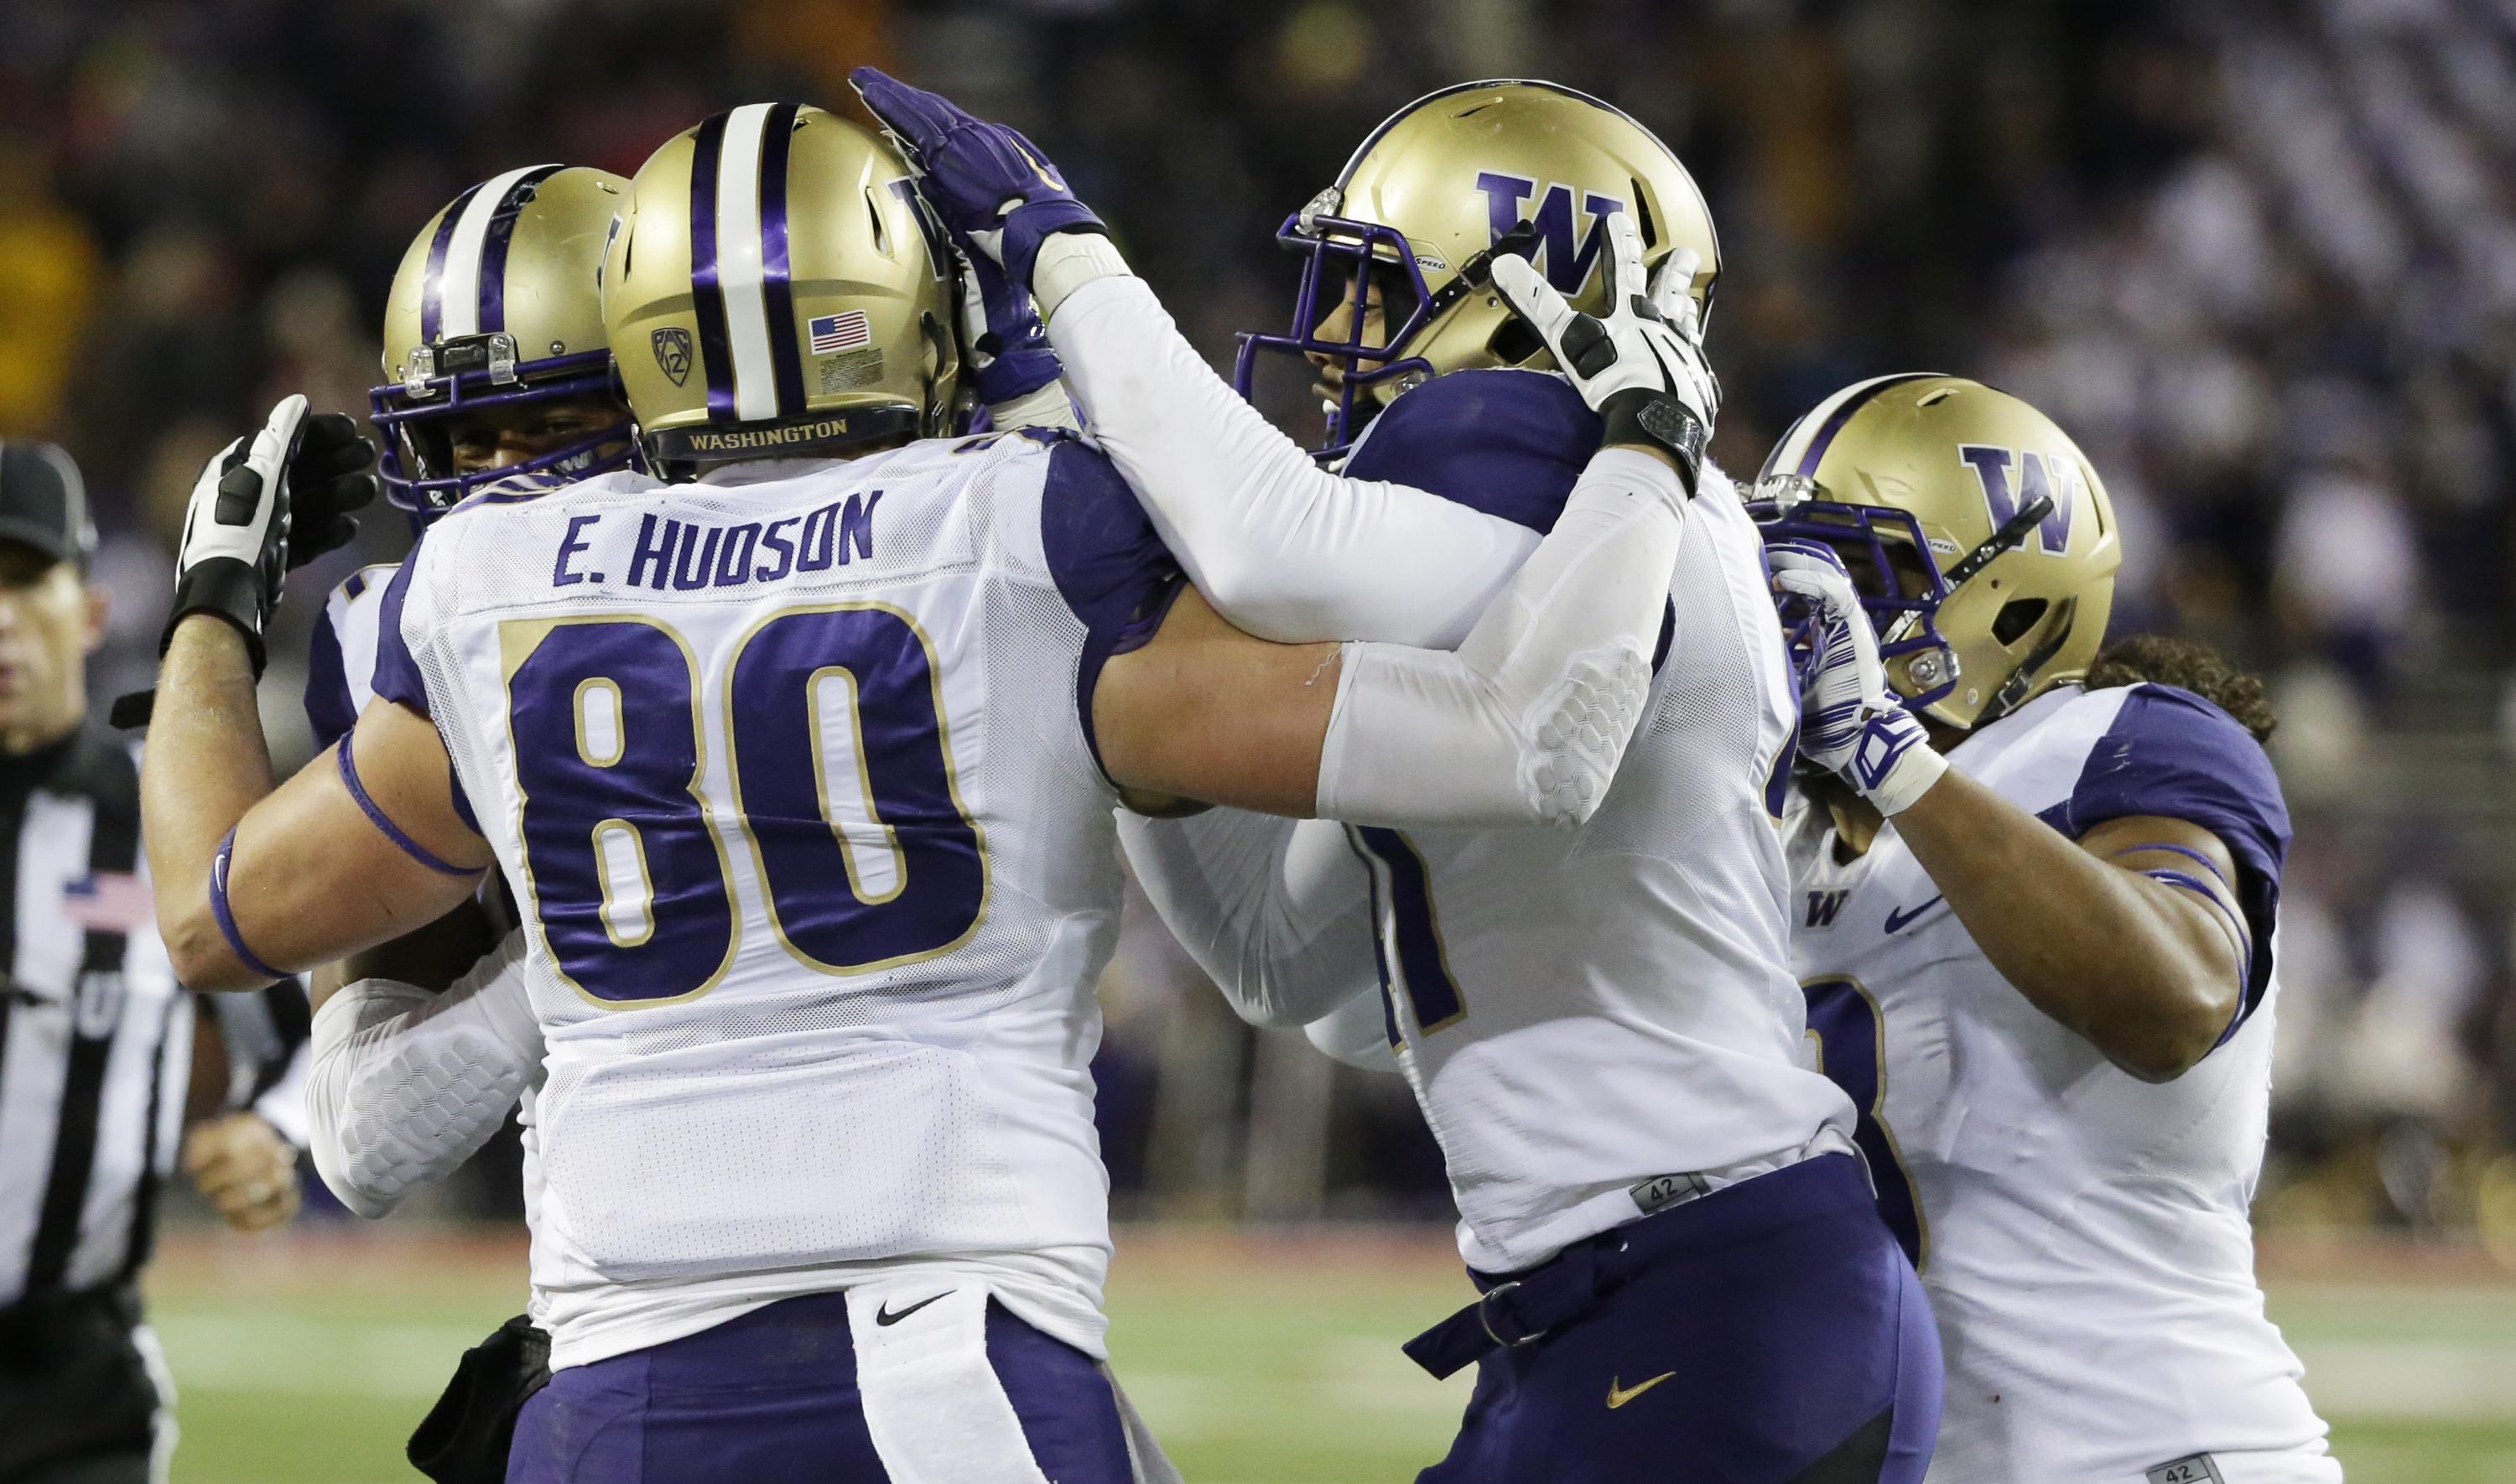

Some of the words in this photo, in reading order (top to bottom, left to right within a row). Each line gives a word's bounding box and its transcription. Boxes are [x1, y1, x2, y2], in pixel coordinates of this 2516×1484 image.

[1474, 169, 1625, 298] W
[1416, 257, 1446, 269] SPEED
[689, 419, 848, 450] WASHINGTON
[1957, 443, 2080, 558] W
[554, 513, 606, 588] E.
[626, 490, 883, 589] HUDSON
[498, 600, 992, 1011] 80
[1805, 889, 1850, 929] W
[1650, 1178, 1678, 1201] 42
[2166, 1465, 2194, 1482] 42
